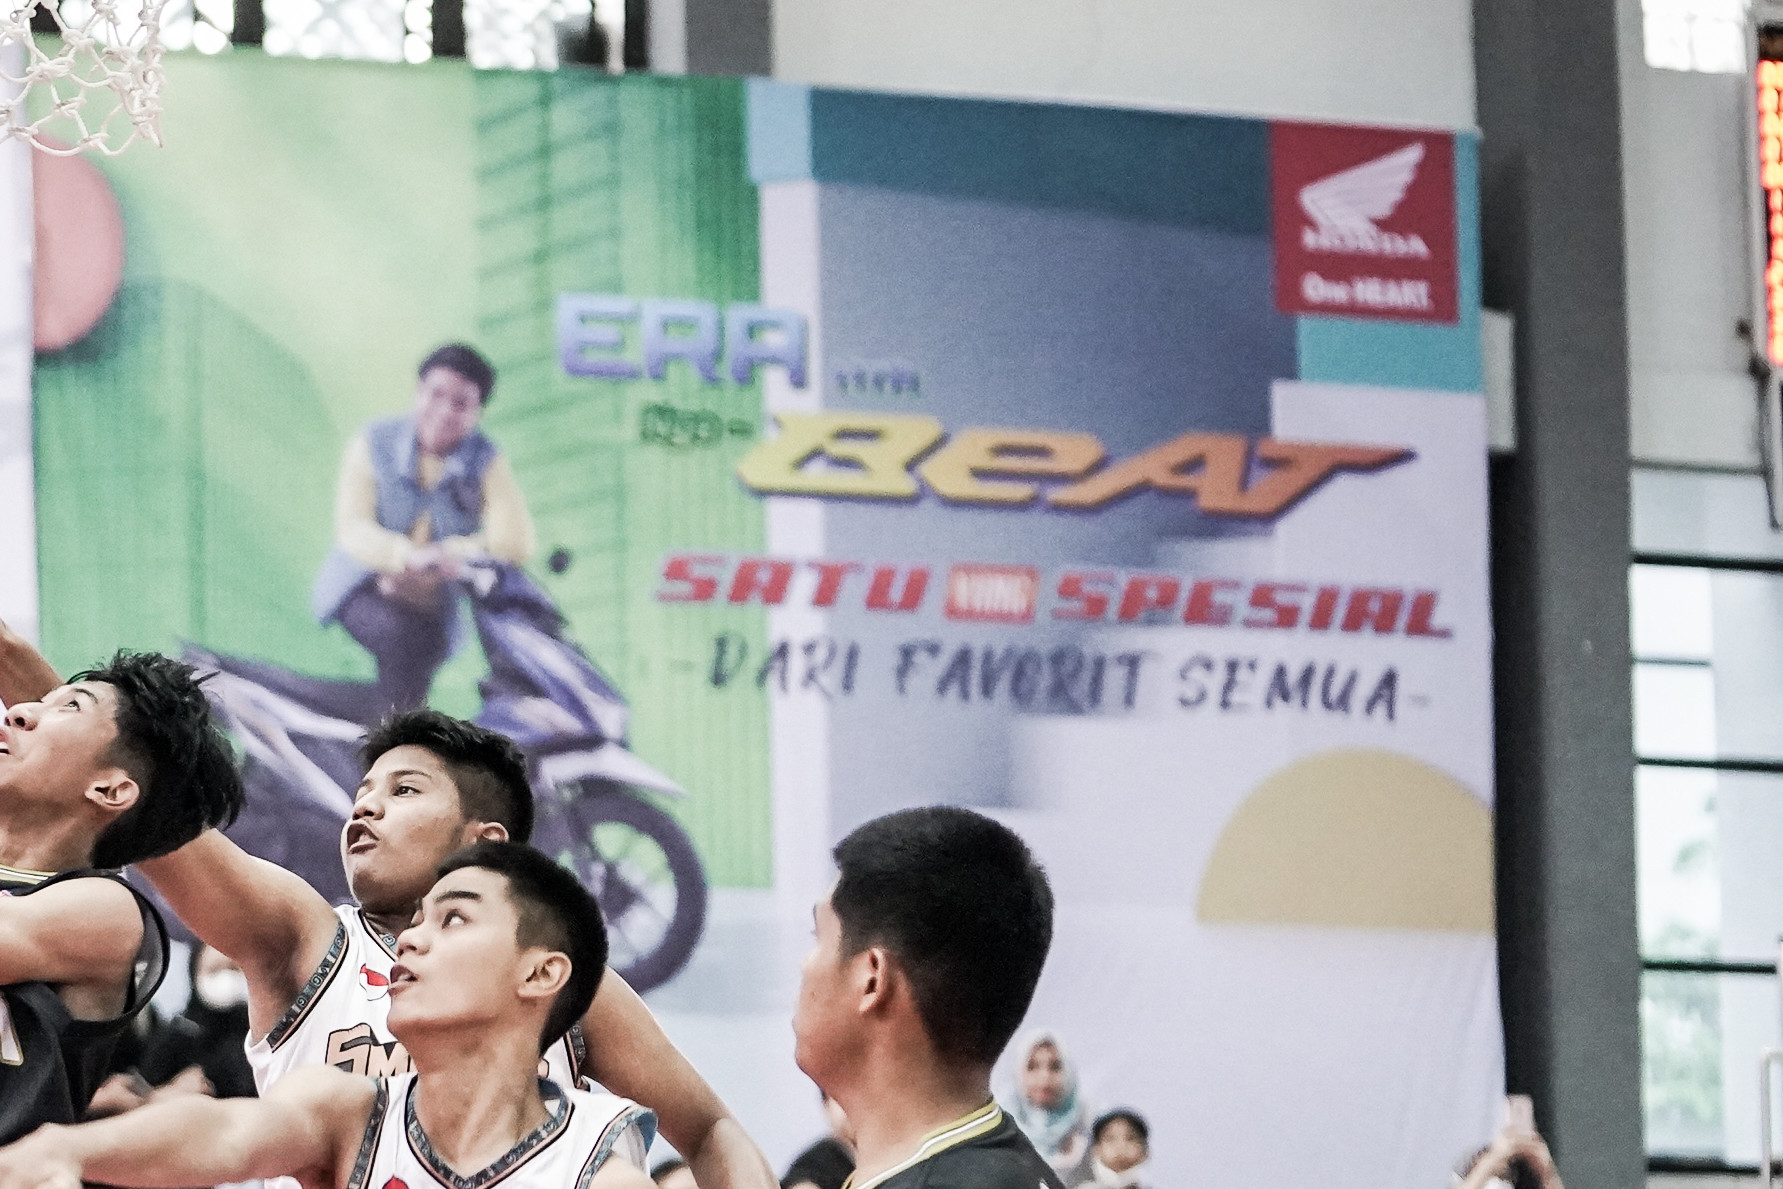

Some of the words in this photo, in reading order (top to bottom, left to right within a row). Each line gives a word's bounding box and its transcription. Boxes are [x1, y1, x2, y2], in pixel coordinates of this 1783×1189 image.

[558, 292, 810, 390] ERA
[656, 553, 930, 613] SATU
[1051, 570, 1454, 640] SPESIAL
[708, 632, 861, 698] DARI
[896, 638, 1156, 711] FAVORIT
[1177, 655, 1399, 722] SEMUA
